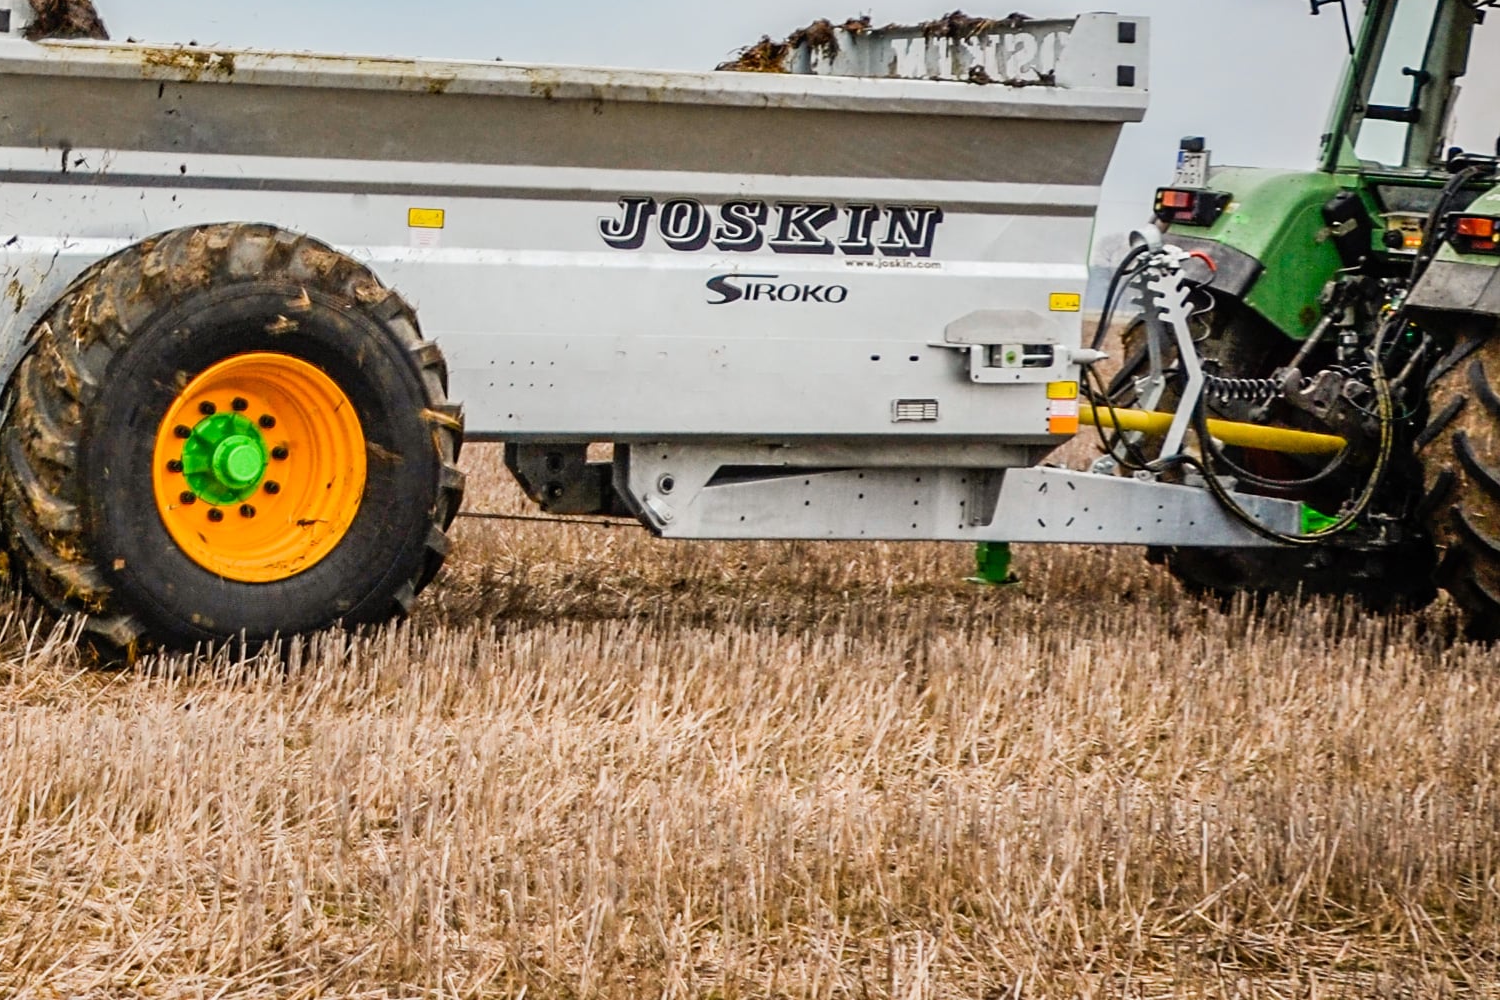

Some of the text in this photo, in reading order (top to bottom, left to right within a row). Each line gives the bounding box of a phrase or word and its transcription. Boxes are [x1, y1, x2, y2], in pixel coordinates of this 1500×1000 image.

[1183, 155, 1201, 168] PCT
[598, 195, 943, 257] JOSKIN
[845, 259, 941, 269] www.joskin.com
[705, 274, 848, 304] SIROKO
